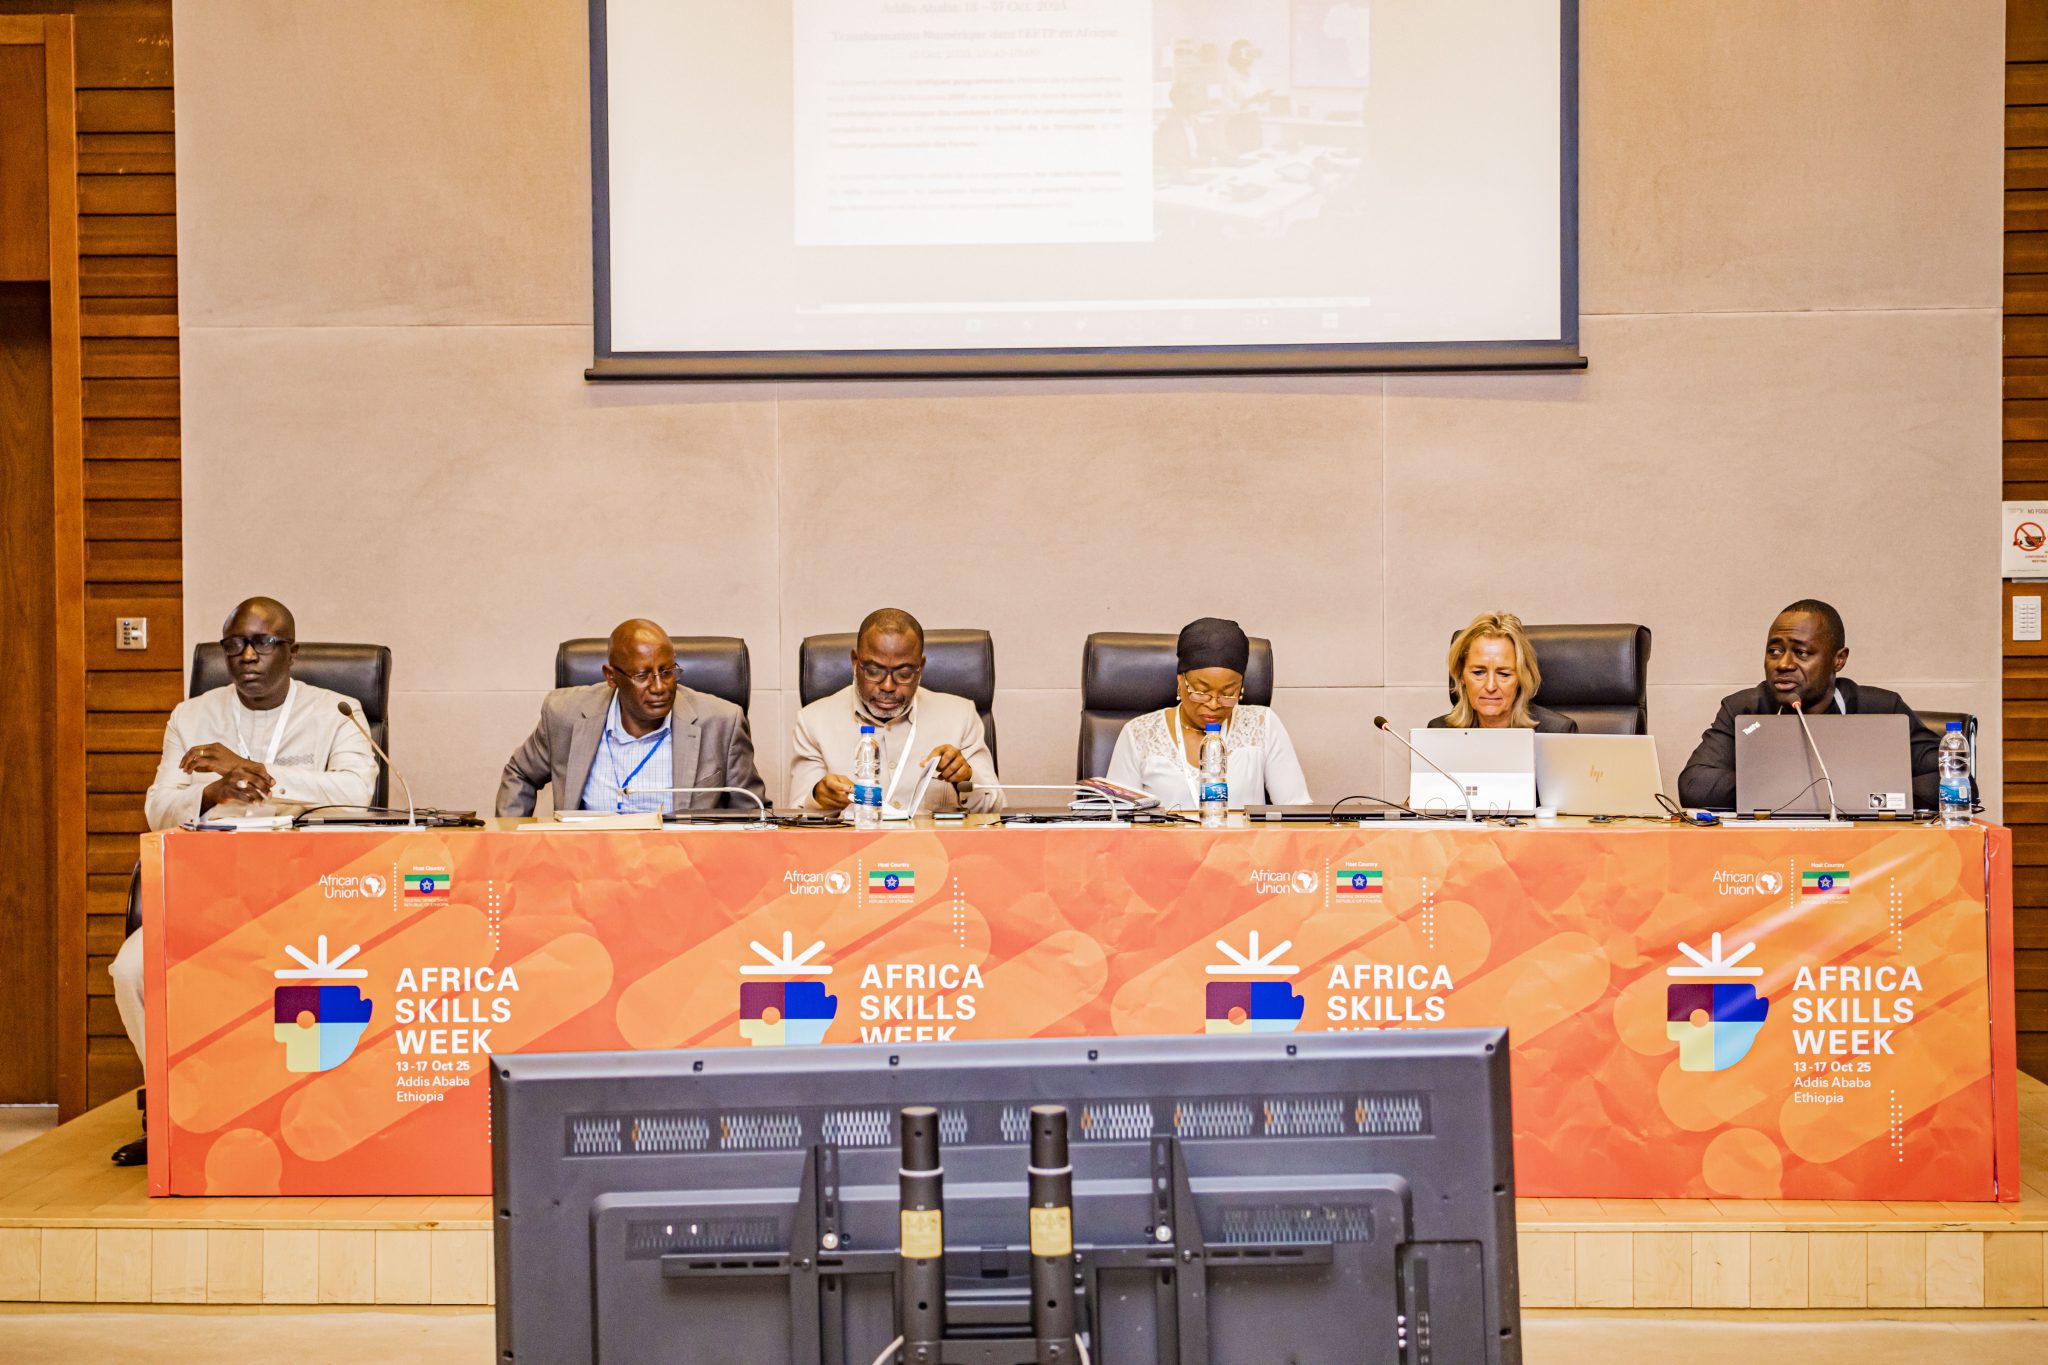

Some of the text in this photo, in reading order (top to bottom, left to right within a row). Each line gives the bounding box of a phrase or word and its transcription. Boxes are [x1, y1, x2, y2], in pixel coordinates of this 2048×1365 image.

[319, 875, 358, 886] African
[784, 871, 823, 882] African
[1250, 870, 1290, 881] African
[1713, 871, 1754, 882] African
[325, 887, 358, 898] Union
[790, 884, 823, 894] Union
[1256, 883, 1290, 893] Union
[1720, 884, 1754, 895] Union
[396, 967, 519, 992] AFRICA
[861, 964, 984, 988] AFRICA
[1328, 965, 1453, 989] AFRICA
[1793, 966, 1922, 991] AFRICA
[396, 998, 511, 1023] SKILLS
[860, 995, 975, 1020] SKILLS
[1328, 996, 1444, 1021] SKILLS
[1792, 997, 1913, 1023] SKILLS
[860, 1026, 957, 1043] WEEK
[396, 1029, 492, 1054] WEEK
[1793, 1030, 1894, 1054] WEEK
[432, 1061, 453, 1071] Oct
[457, 1061, 469, 1070] 25
[1831, 1061, 1852, 1072] Oct
[1857, 1062, 1871, 1072] 25
[397, 1076, 469, 1086] Addis Ababa
[1794, 1077, 1871, 1087] Addis Ababa
[397, 1091, 443, 1103] Ethiopia
[1795, 1092, 1843, 1104] Ethiopia
